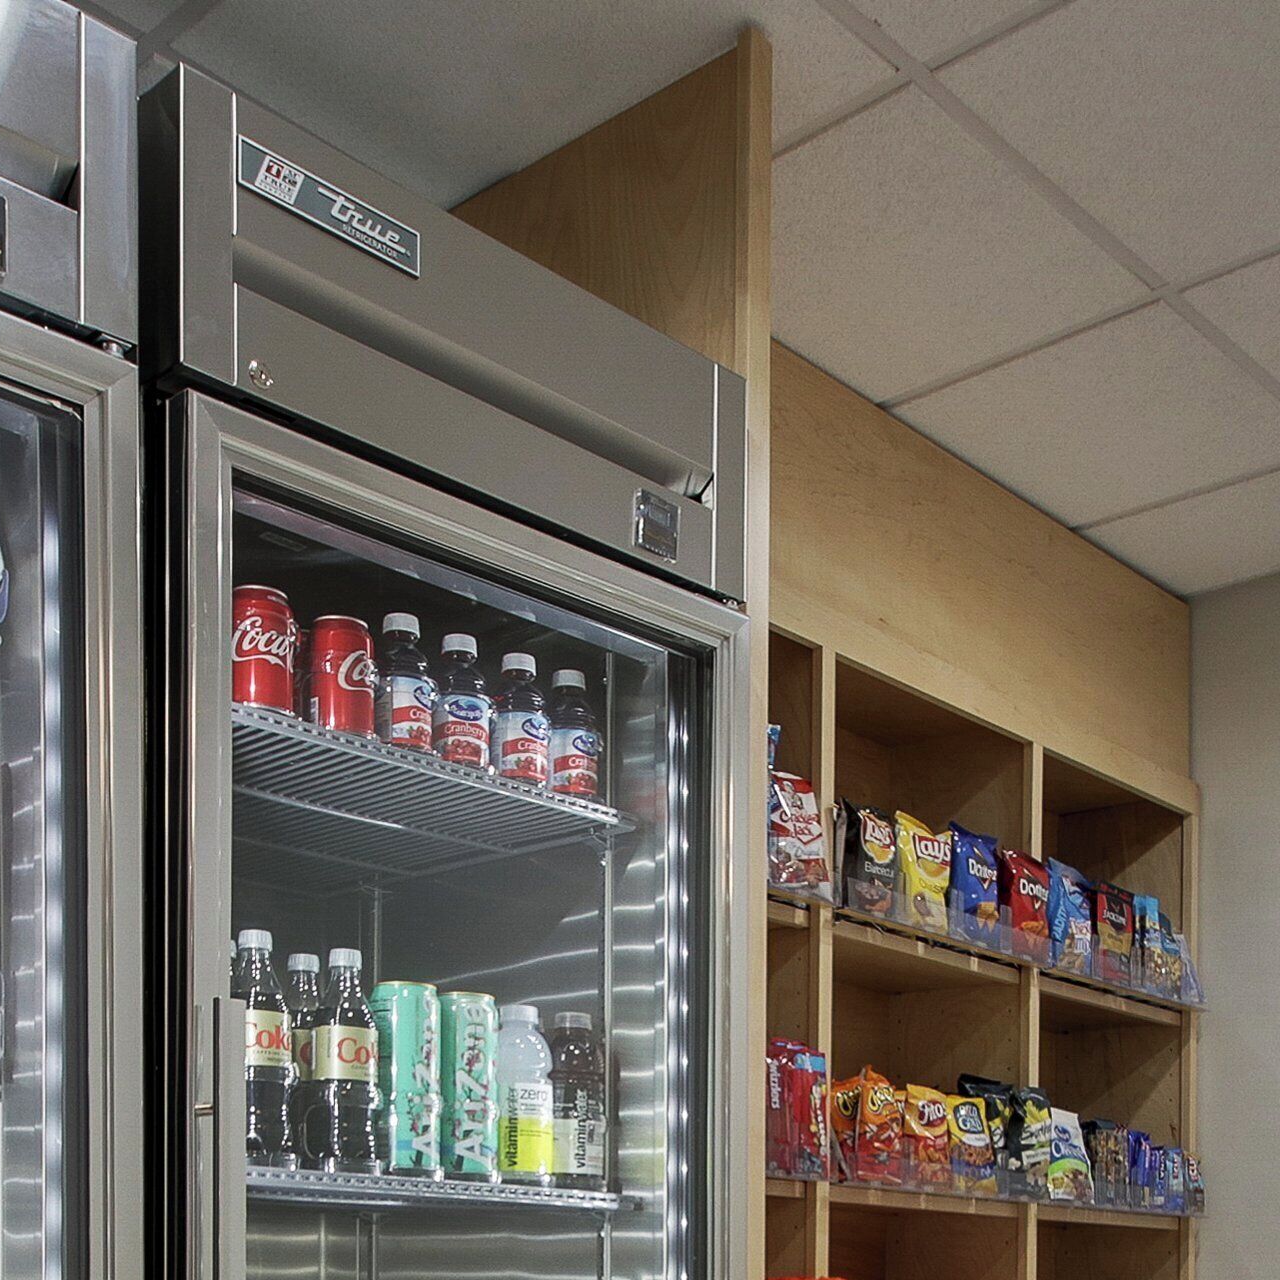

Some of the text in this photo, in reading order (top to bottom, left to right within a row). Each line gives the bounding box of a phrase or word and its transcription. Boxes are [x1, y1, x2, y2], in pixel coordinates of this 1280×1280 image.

[342, 224, 398, 258] REFRIGERATOR
[444, 722, 487, 742] Cranberry
[520, 1088, 547, 1101] zero
